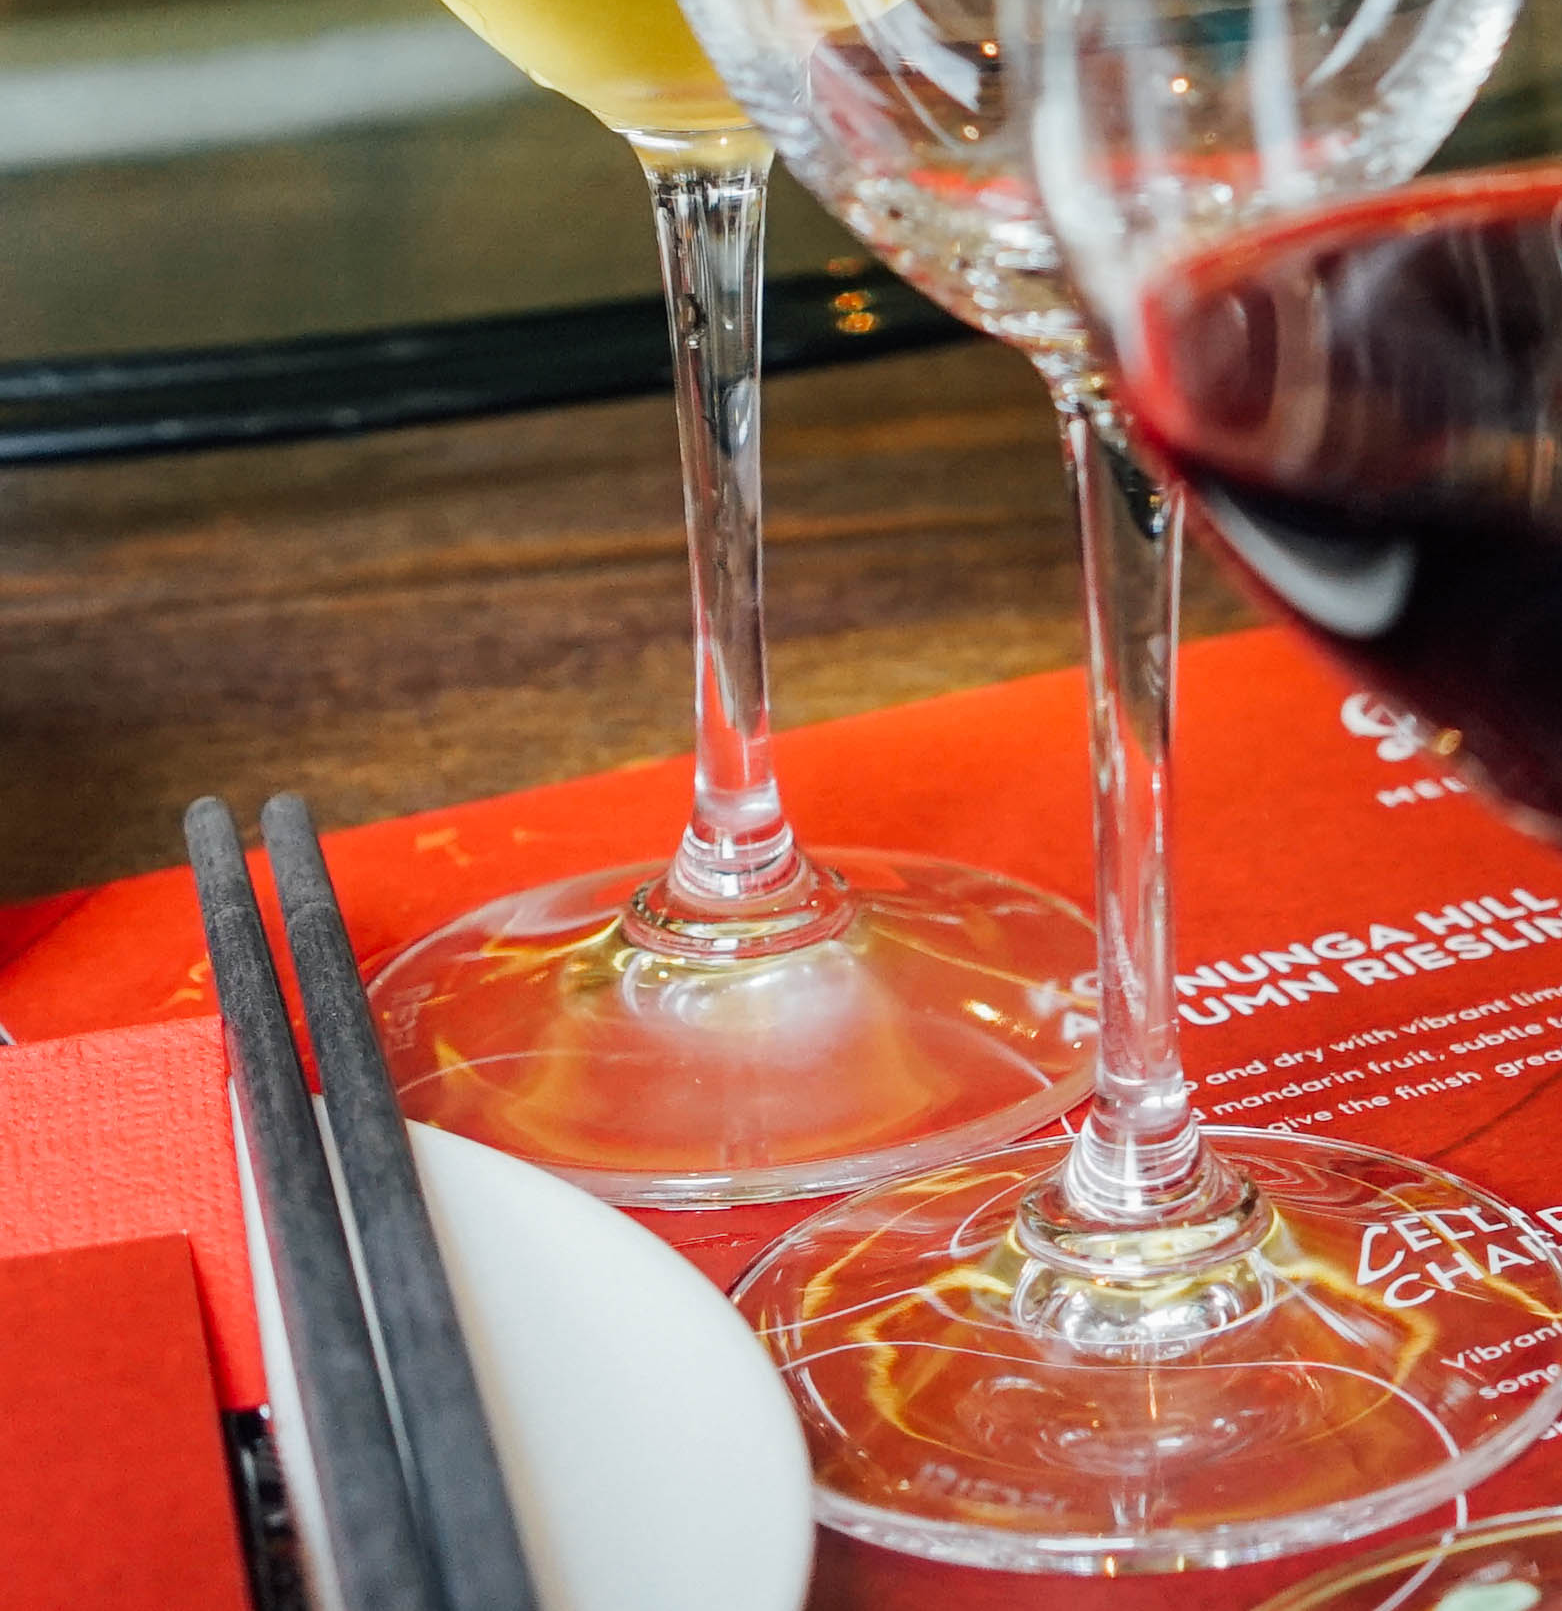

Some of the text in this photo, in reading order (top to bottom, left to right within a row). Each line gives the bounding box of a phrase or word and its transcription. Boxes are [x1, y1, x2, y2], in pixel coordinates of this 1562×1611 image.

[1415, 888, 1559, 933] HILL
[1207, 1061, 1268, 1087] and
[1273, 1045, 1325, 1071] dry
[1329, 1026, 1398, 1055] with
[1400, 999, 1510, 1035] vibrant
[1212, 1070, 1363, 1116] mandarin
[1367, 1050, 1446, 1080] fruit,
[1449, 1023, 1544, 1057] subtle
[1337, 1094, 1391, 1116] the
[1394, 1069, 1482, 1100] finish
